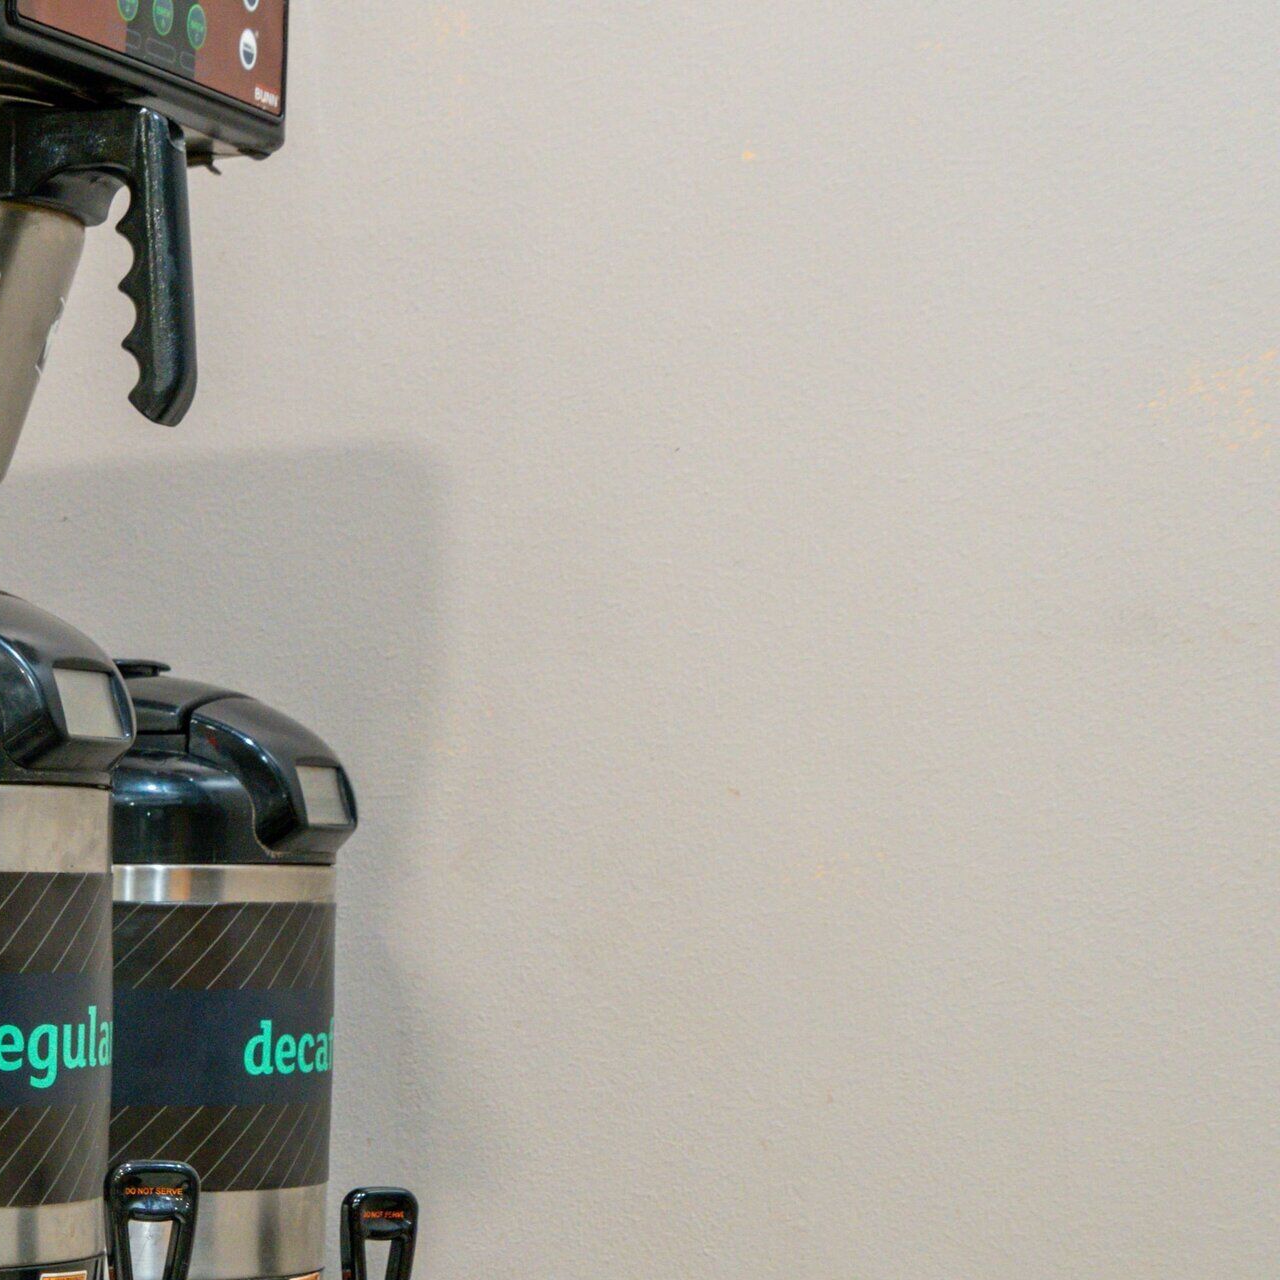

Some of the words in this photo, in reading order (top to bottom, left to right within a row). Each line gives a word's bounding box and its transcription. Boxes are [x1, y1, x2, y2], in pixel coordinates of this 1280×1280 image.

[254, 86, 278, 108] BUNN
[125, 1187, 136, 1195] DO
[138, 1187, 153, 1195] NOT
[155, 1187, 183, 1196] SERVE
